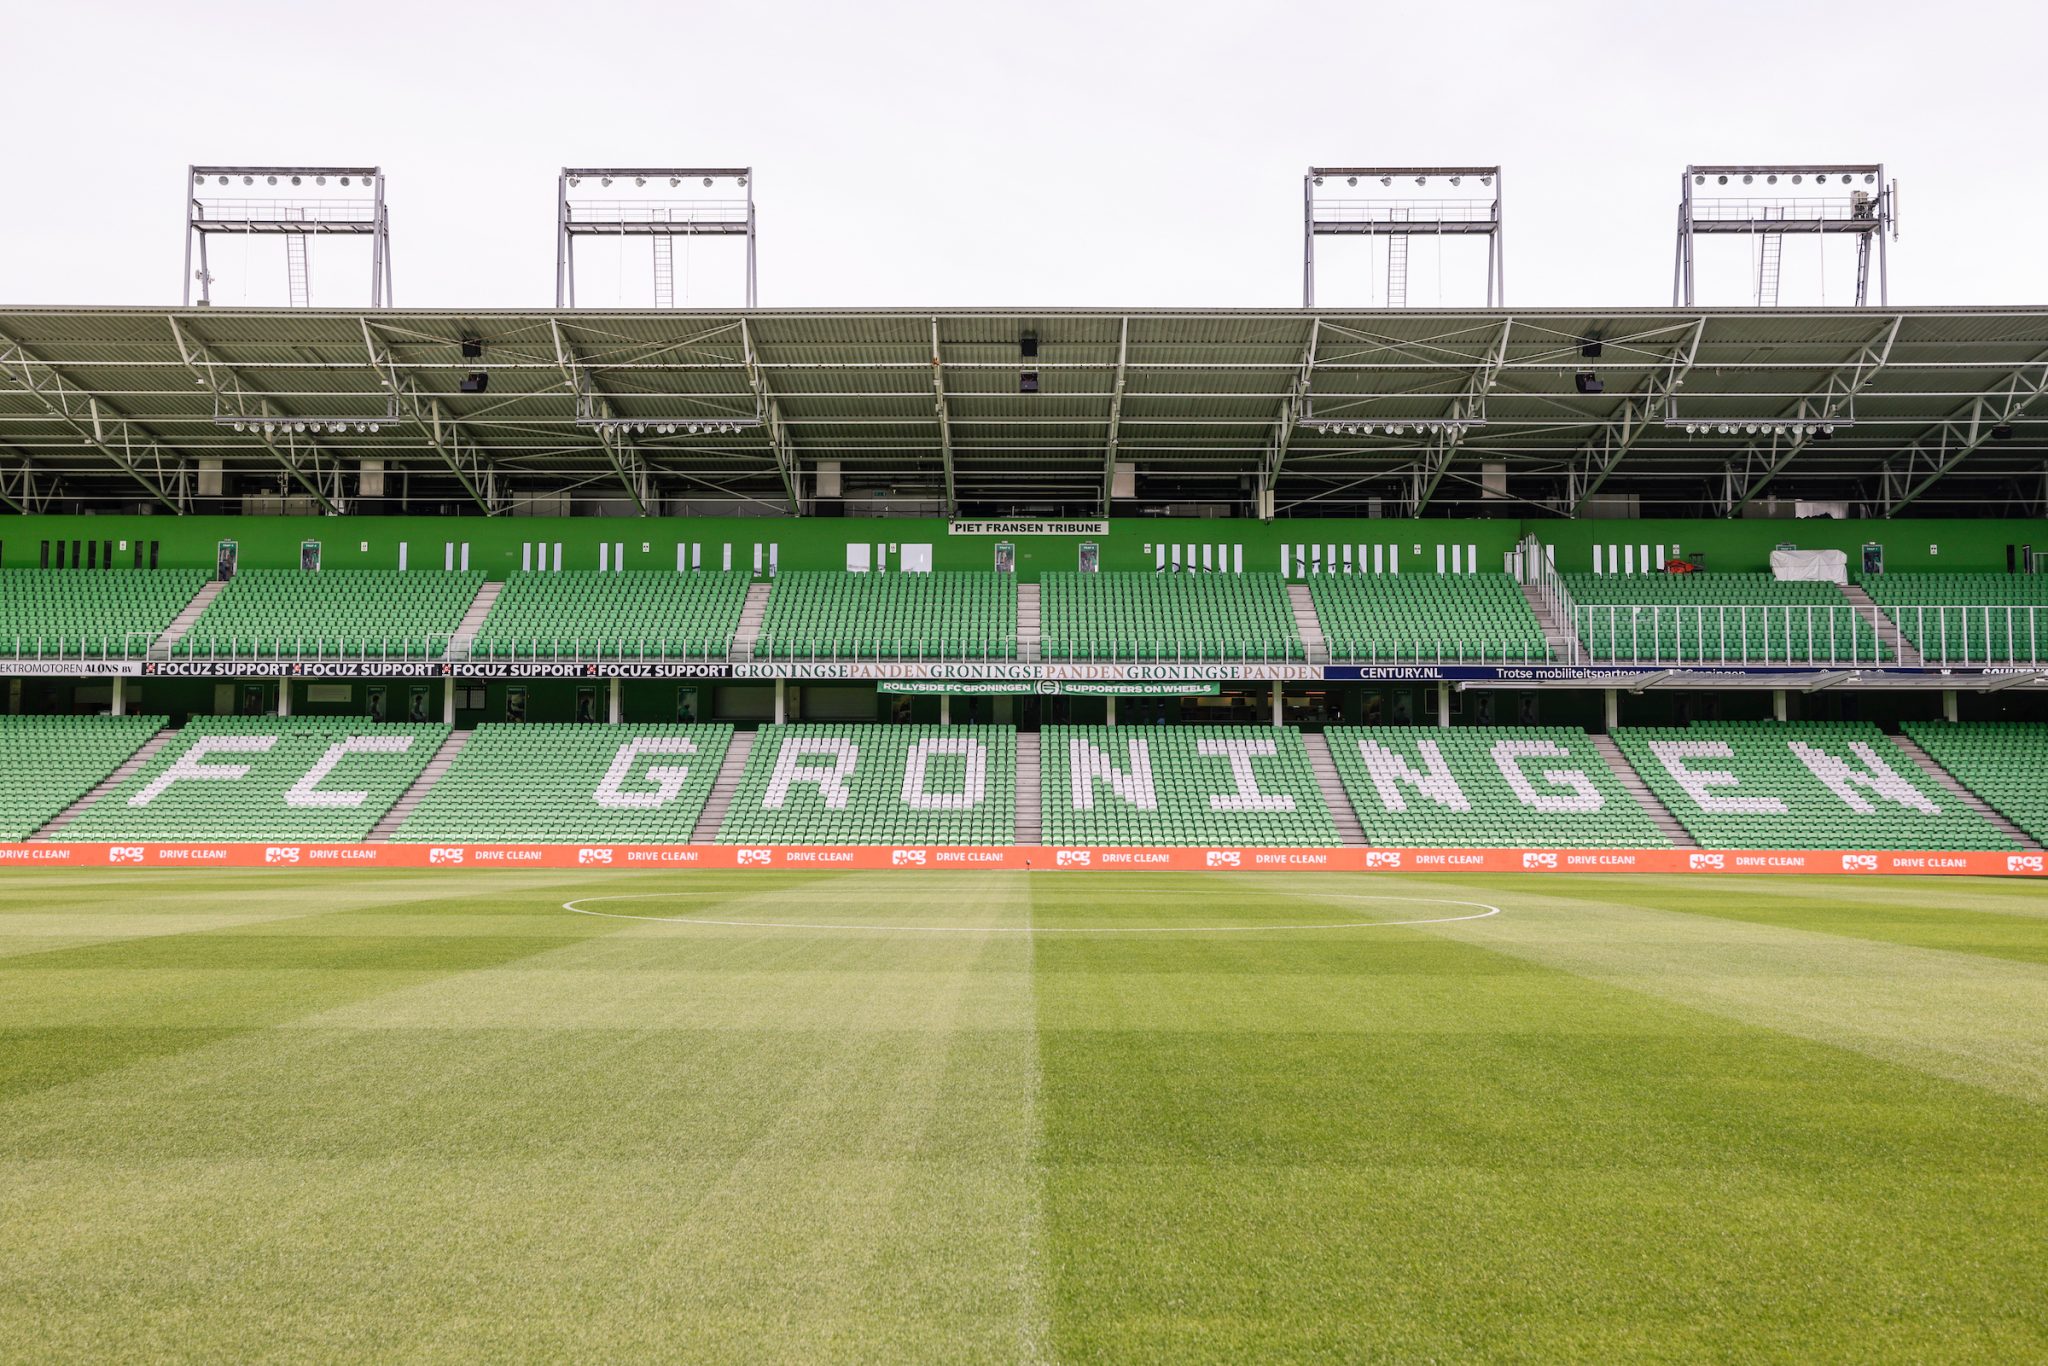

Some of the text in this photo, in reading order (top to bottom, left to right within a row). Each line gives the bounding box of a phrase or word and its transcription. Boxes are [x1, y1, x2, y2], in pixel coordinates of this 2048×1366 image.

[955, 523, 1102, 533] PIET FRANSEN TRIBUNE
[0, 663, 83, 673] EKTROMOTOREN
[122, 665, 133, 673] BV
[157, 663, 290, 675] FOCUZ SUPPORT
[303, 663, 435, 676] FOCUZ SUPPORT
[452, 664, 584, 677] FOCUZ SUPPORT
[598, 664, 729, 677] FOCUZ SUPPORT
[1359, 667, 1443, 679] CENTURY.NL
[1496, 668, 1533, 679] Trotse
[883, 682, 1031, 692] ROLLYSIDE FC GRONINGEN
[1065, 684, 1212, 693] SUPPORTERS ON WHEELS
[0, 849, 70, 859] DRIVE CLEAN!
[159, 849, 227, 859] DRIVE CLEAN!
[309, 849, 377, 859] DRIVE CLEAN!
[475, 849, 542, 859] DRIVE CLEAN!
[627, 851, 698, 861] DRIVE CLEAN!
[786, 852, 854, 862] DRIVE CLEAN!
[936, 852, 1003, 862] DRIVE CLEAN!
[1102, 853, 1170, 863] DRIVE CLEAN!
[1255, 854, 1327, 864] DRIVE CLEAN!
[1415, 854, 1484, 864] DRIVE CLEAN!
[1567, 855, 1636, 865] DRIVE CLEAN!
[1735, 856, 1805, 866] DRIVE CLEAN!
[1893, 857, 1967, 867] DRIVE CLEAN!
